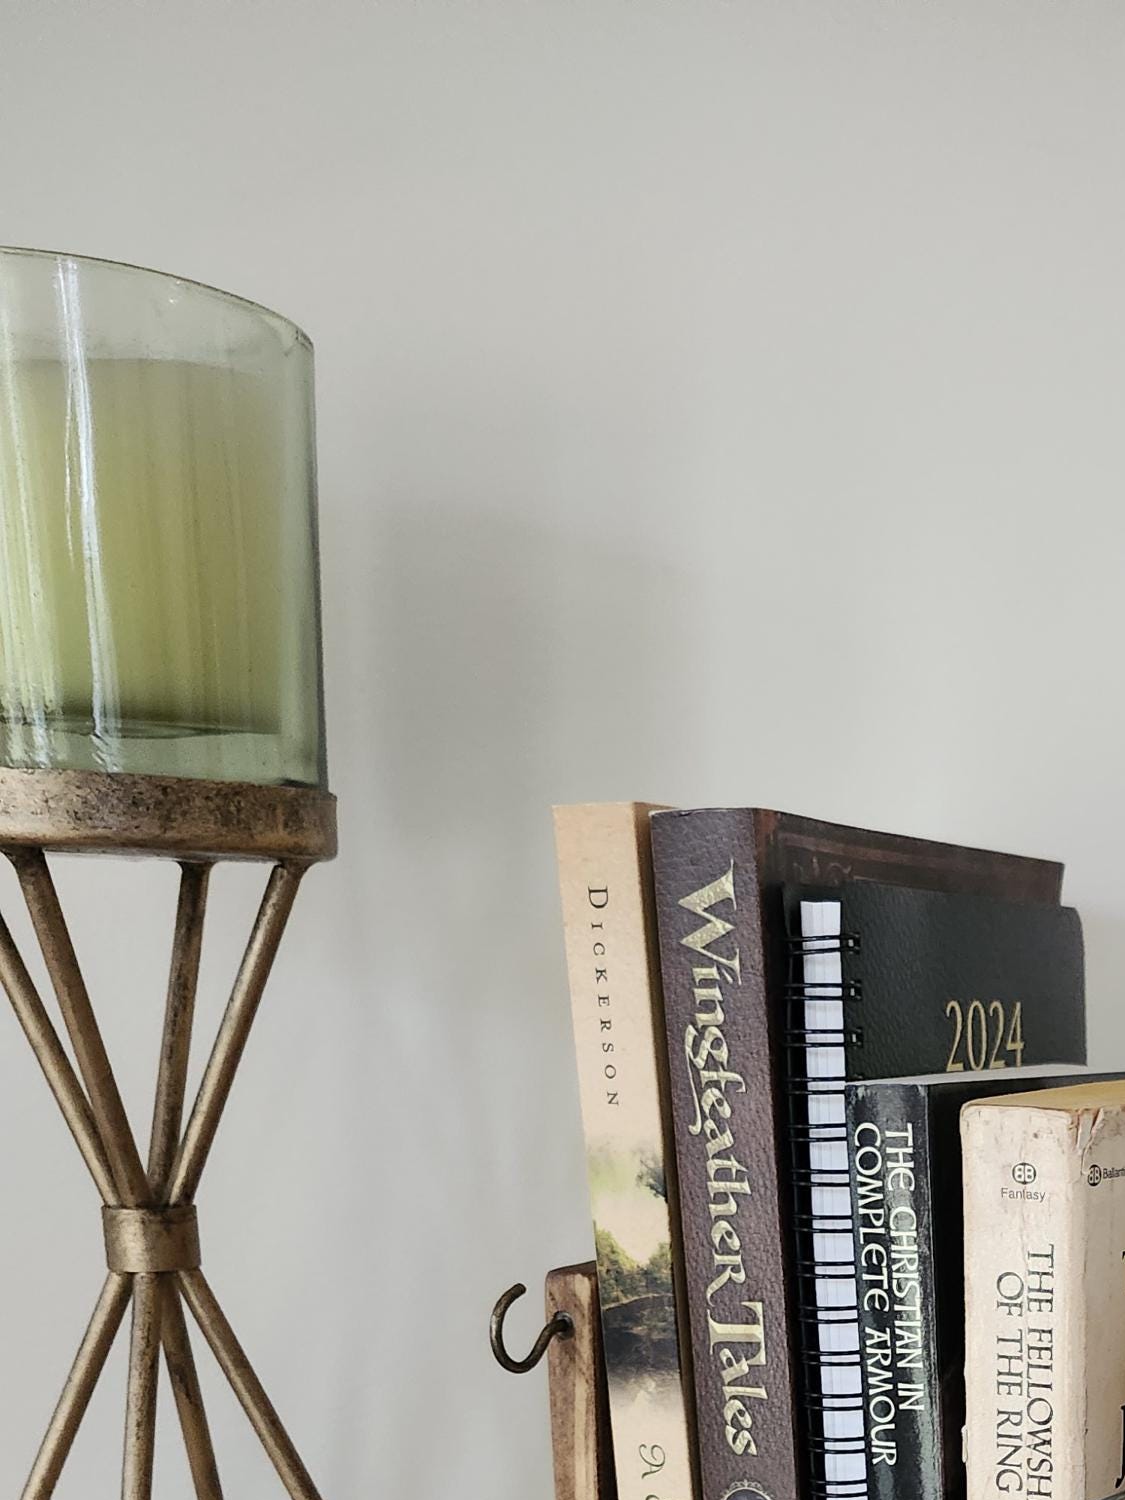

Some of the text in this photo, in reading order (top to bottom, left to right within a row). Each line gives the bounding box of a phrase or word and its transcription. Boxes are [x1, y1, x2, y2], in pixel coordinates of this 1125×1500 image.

[587, 885, 620, 1107] DICKERSON
[945, 999, 1025, 1073] 2024
[884, 1122, 925, 1411] THE CHRISTIAN IN
[1000, 1187, 1046, 1203] Fantasy
[1026, 1243, 1055, 1313] THE
[706, 1300, 768, 1457] Tales
[854, 1121, 897, 1466] COMPLETE ARMOUR
[995, 1271, 1024, 1493] OF THE RING
